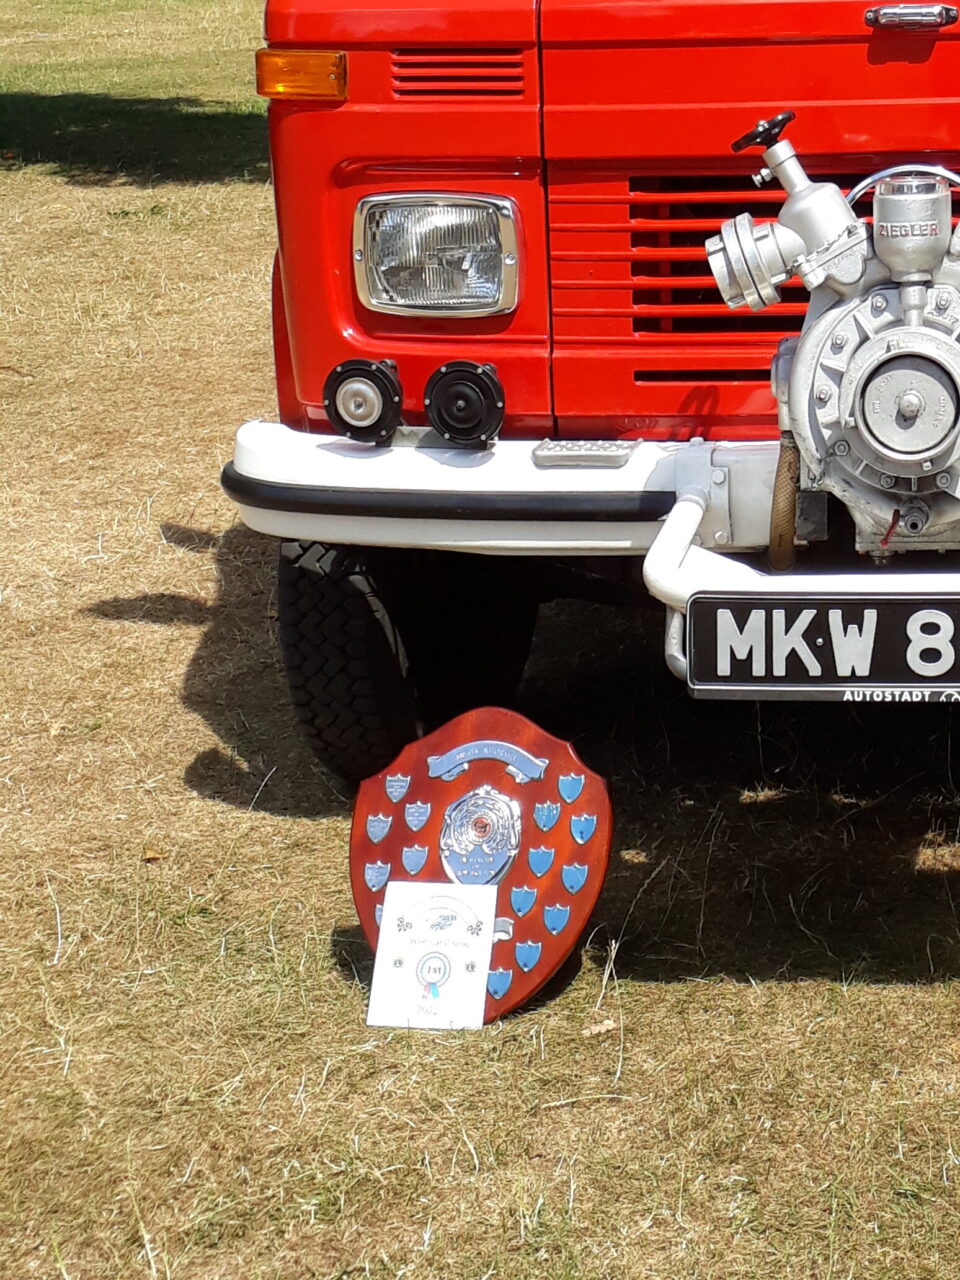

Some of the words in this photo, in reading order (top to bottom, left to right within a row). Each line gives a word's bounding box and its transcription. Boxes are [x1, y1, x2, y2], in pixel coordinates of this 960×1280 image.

[879, 223, 939, 237] ZIEGLER
[716, 608, 877, 677] MKW
[843, 690, 931, 701] AUTOSTADT
